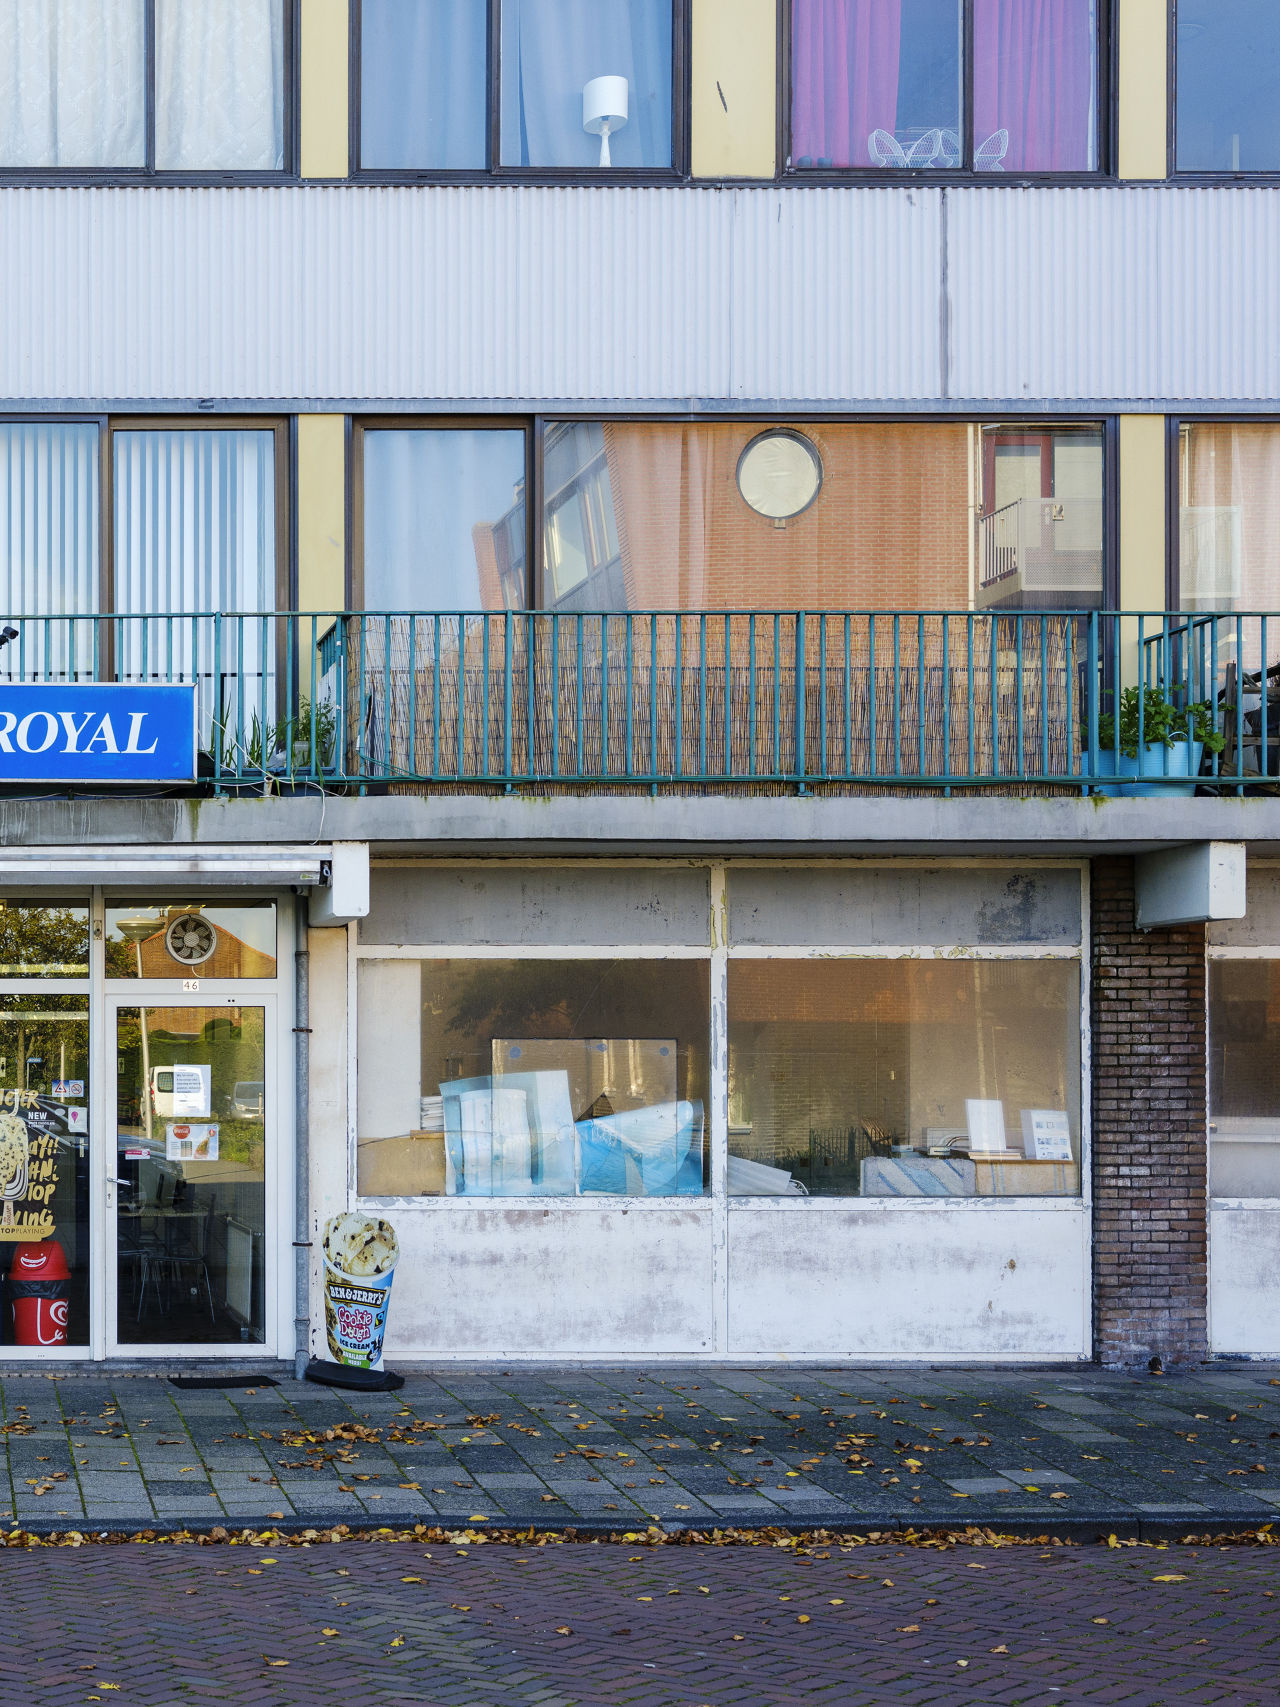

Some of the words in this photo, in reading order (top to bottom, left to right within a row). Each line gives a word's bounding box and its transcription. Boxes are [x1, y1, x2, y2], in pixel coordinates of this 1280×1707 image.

[183, 981, 198, 990] 46
[28, 1111, 47, 1120] NEW
[338, 1307, 372, 1325] Cookie
[340, 1322, 371, 1342] Dough
[339, 1338, 349, 1347] ICE
[350, 1342, 370, 1350] CREAM
